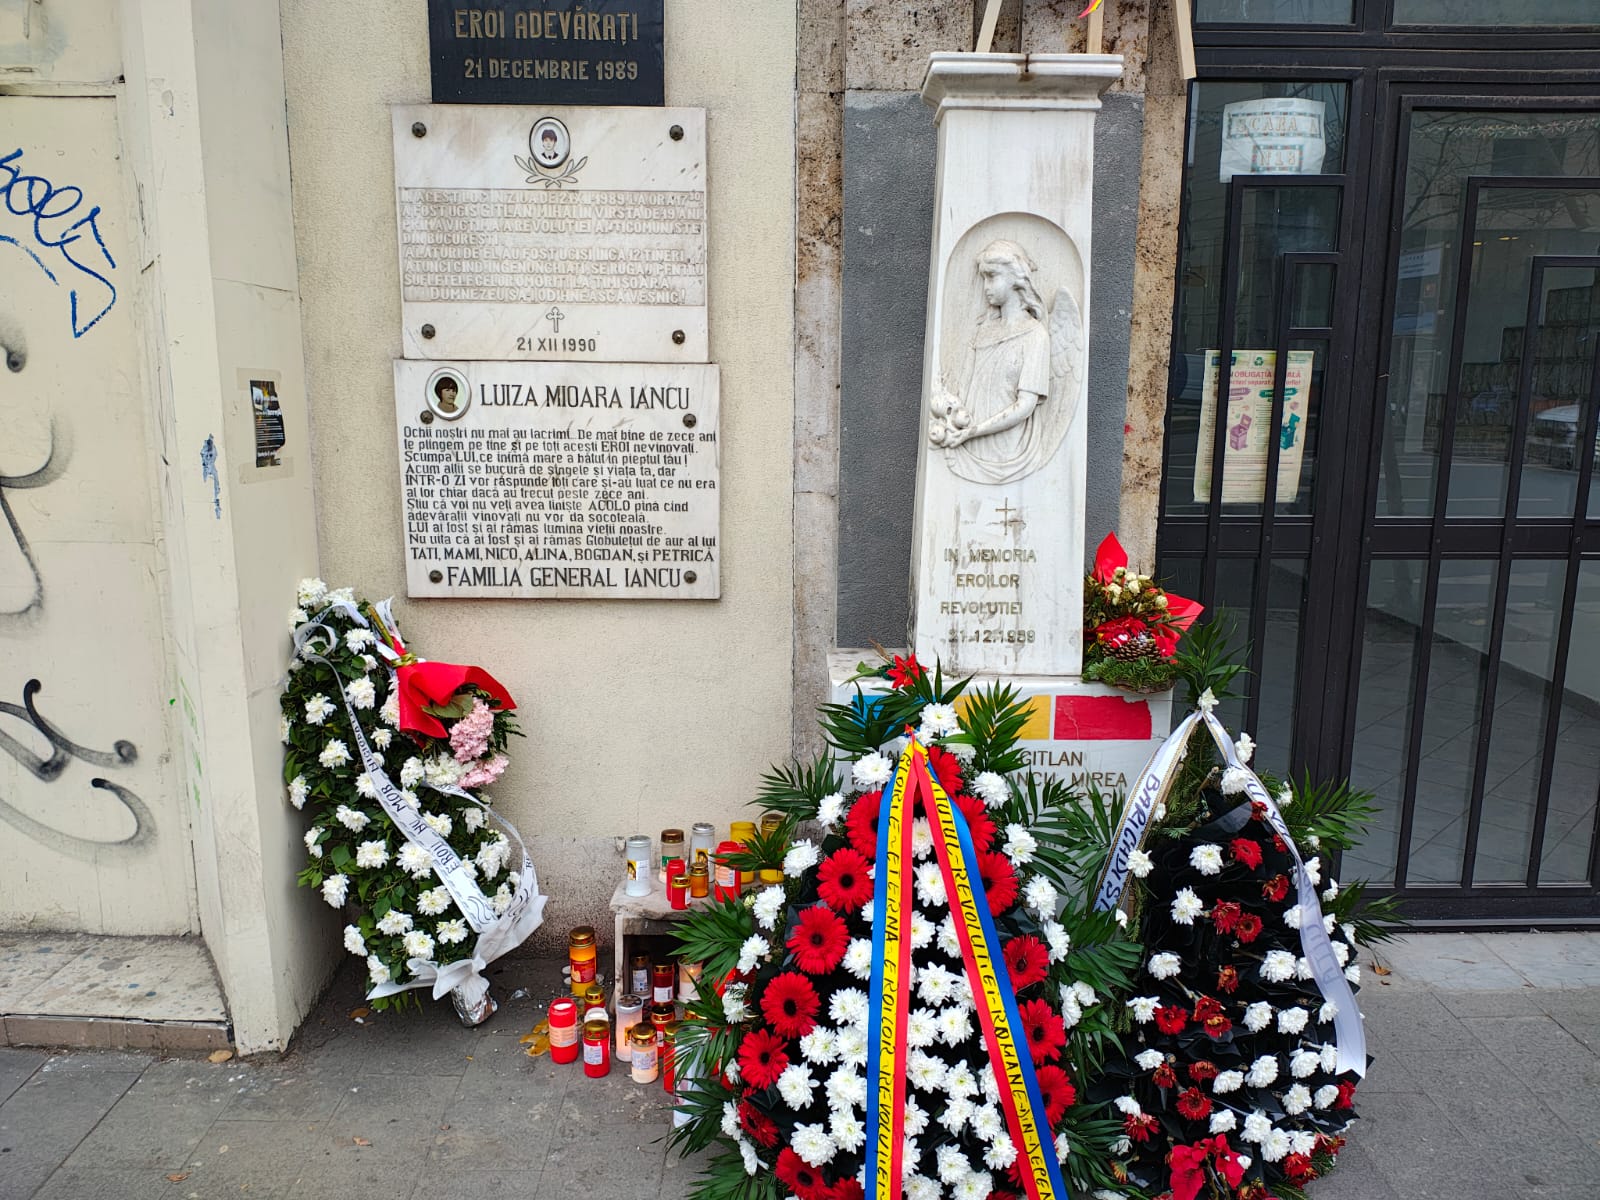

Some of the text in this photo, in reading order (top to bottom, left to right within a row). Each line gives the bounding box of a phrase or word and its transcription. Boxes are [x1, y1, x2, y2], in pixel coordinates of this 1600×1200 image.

[455, 9, 505, 38] EROI
[464, 58, 638, 80] 21 DECEMBRIE 1989
[517, 337, 596, 352] 21 XII 1990
[480, 384, 690, 410] LUIZA MIOARA IANCU
[944, 548, 1037, 563] IN MEMORIA
[447, 567, 681, 588] FAMILIA GENERAL IANCU
[956, 574, 1020, 588] EROILOR
[888, 751, 914, 830] GLORIE
[881, 959, 898, 1056] EROILOR
